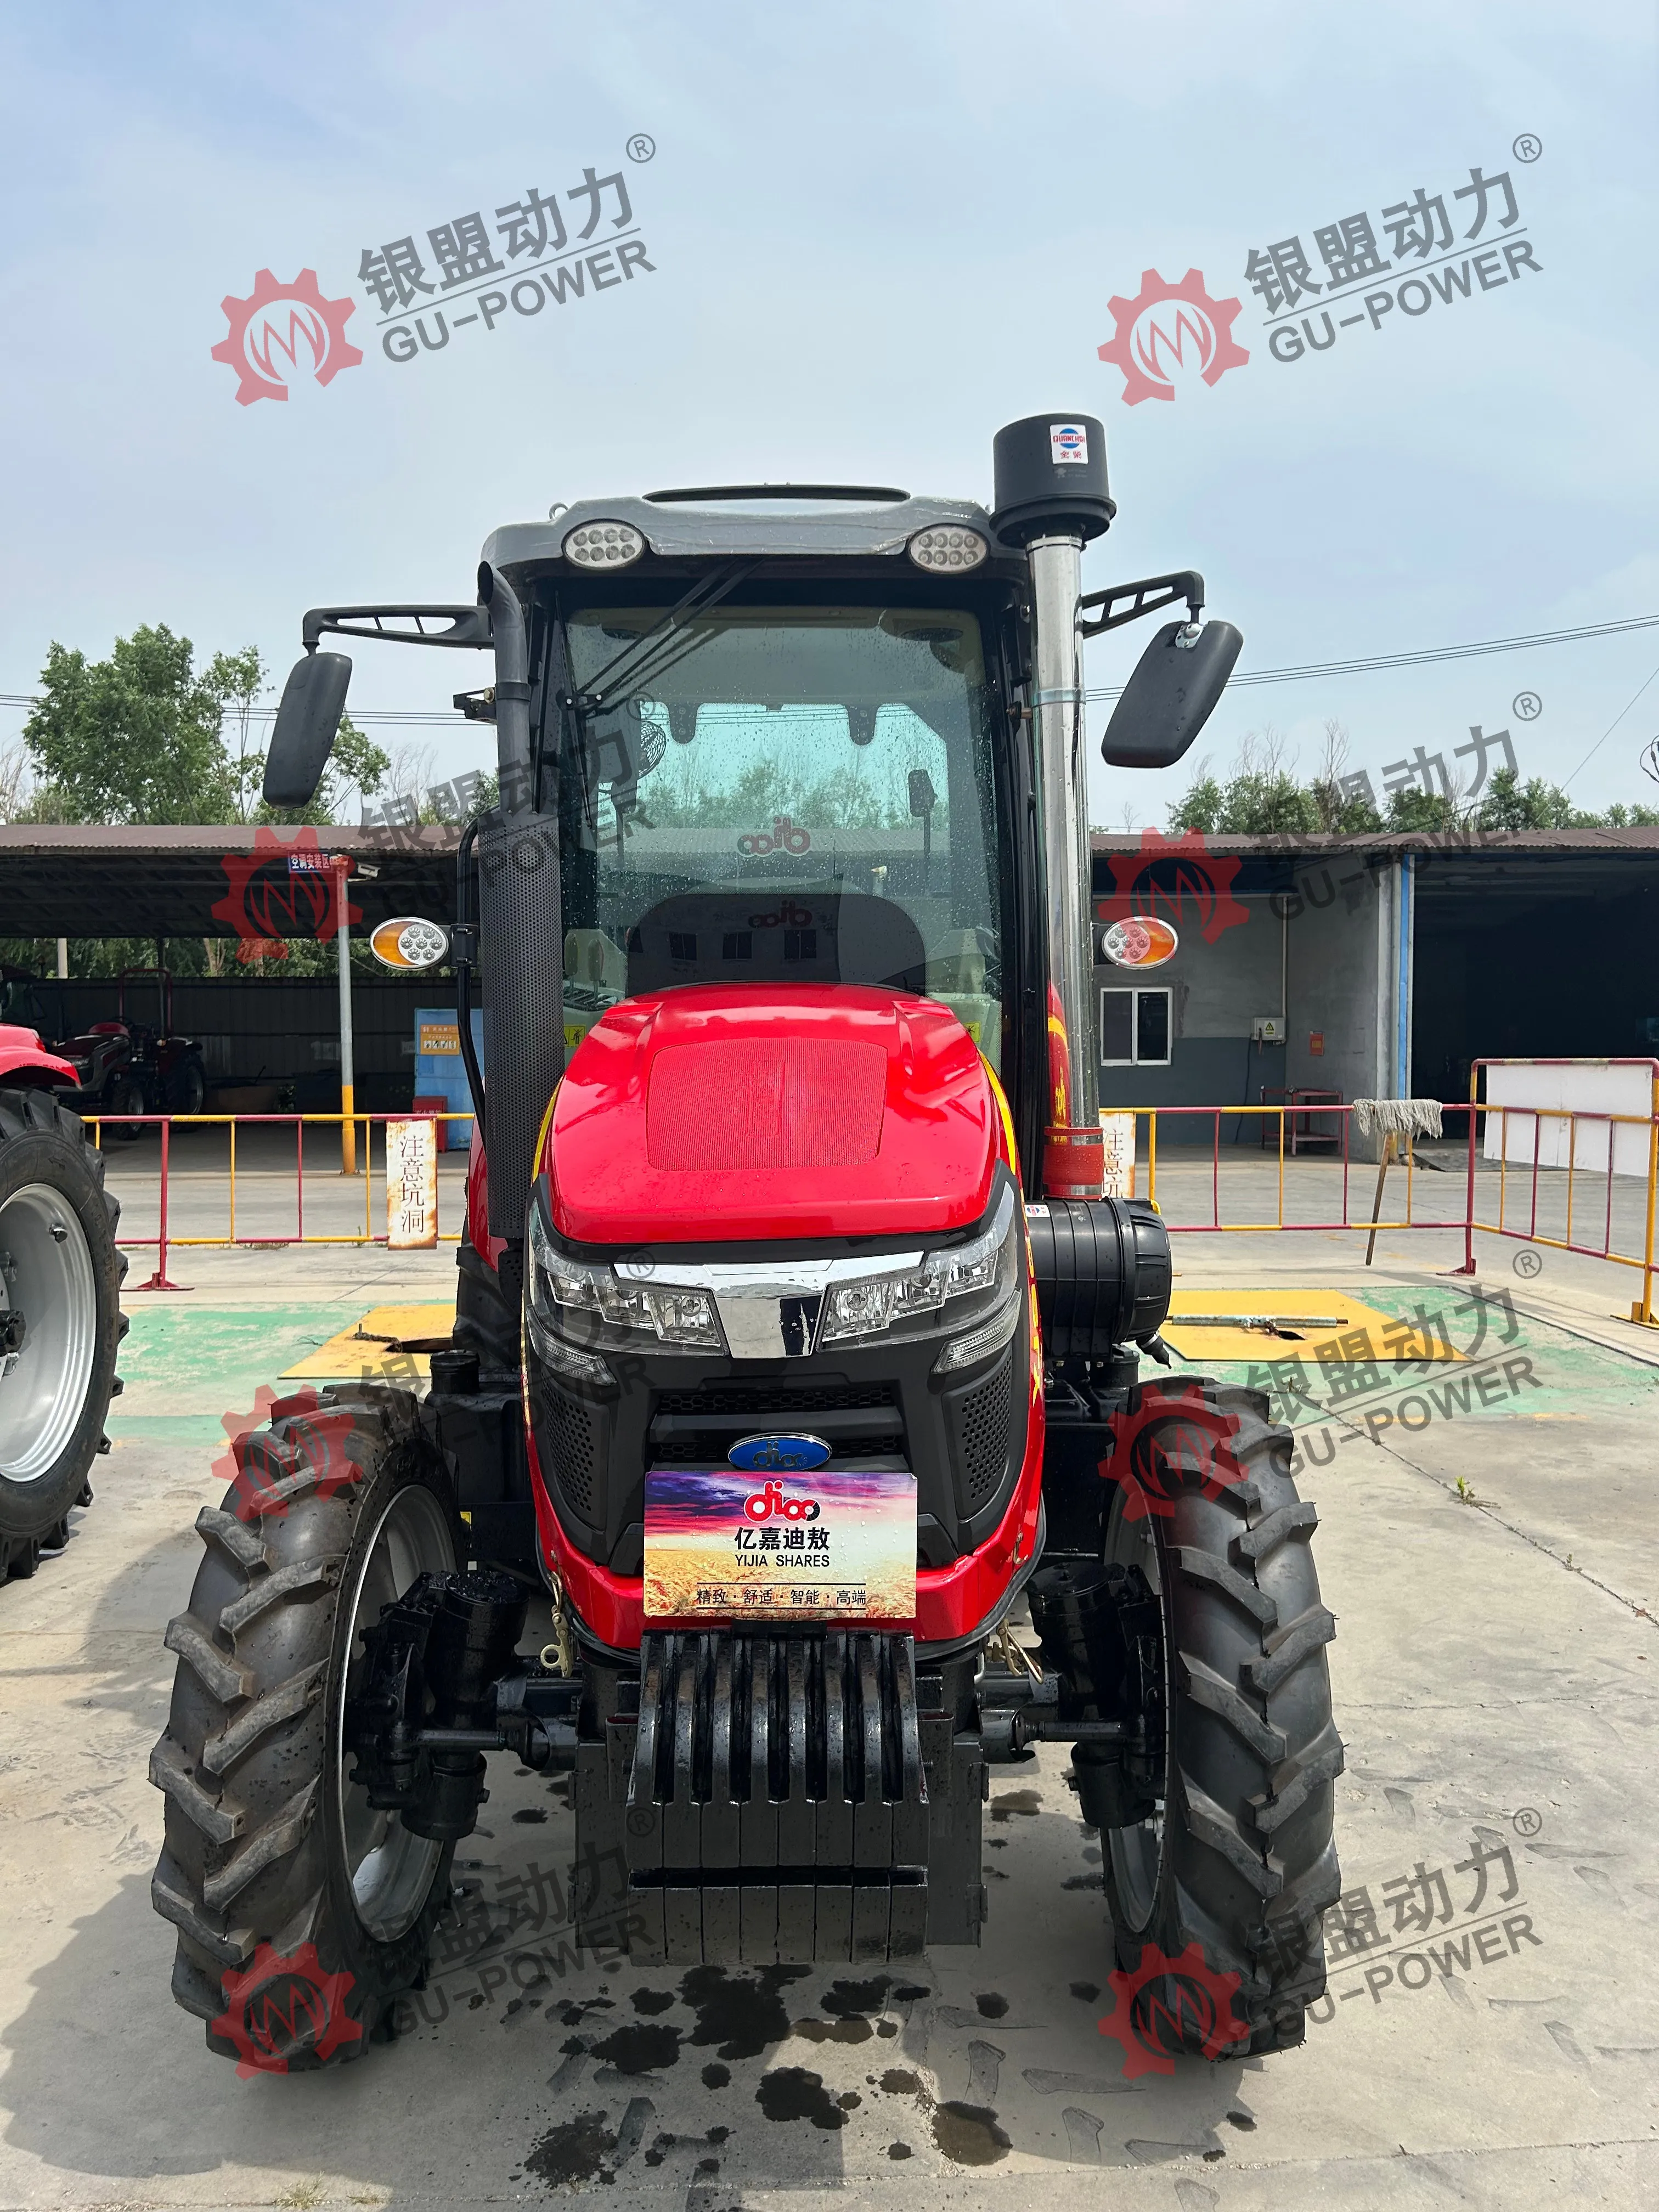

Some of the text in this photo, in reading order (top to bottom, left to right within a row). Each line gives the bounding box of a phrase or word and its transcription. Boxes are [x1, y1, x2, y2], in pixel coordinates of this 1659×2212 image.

[398, 1135, 425, 1234] 注意坑洞
[734, 1526, 830, 1550] 亿嘉迪敖
[735, 1554, 830, 1567] YIJIA SHARES
